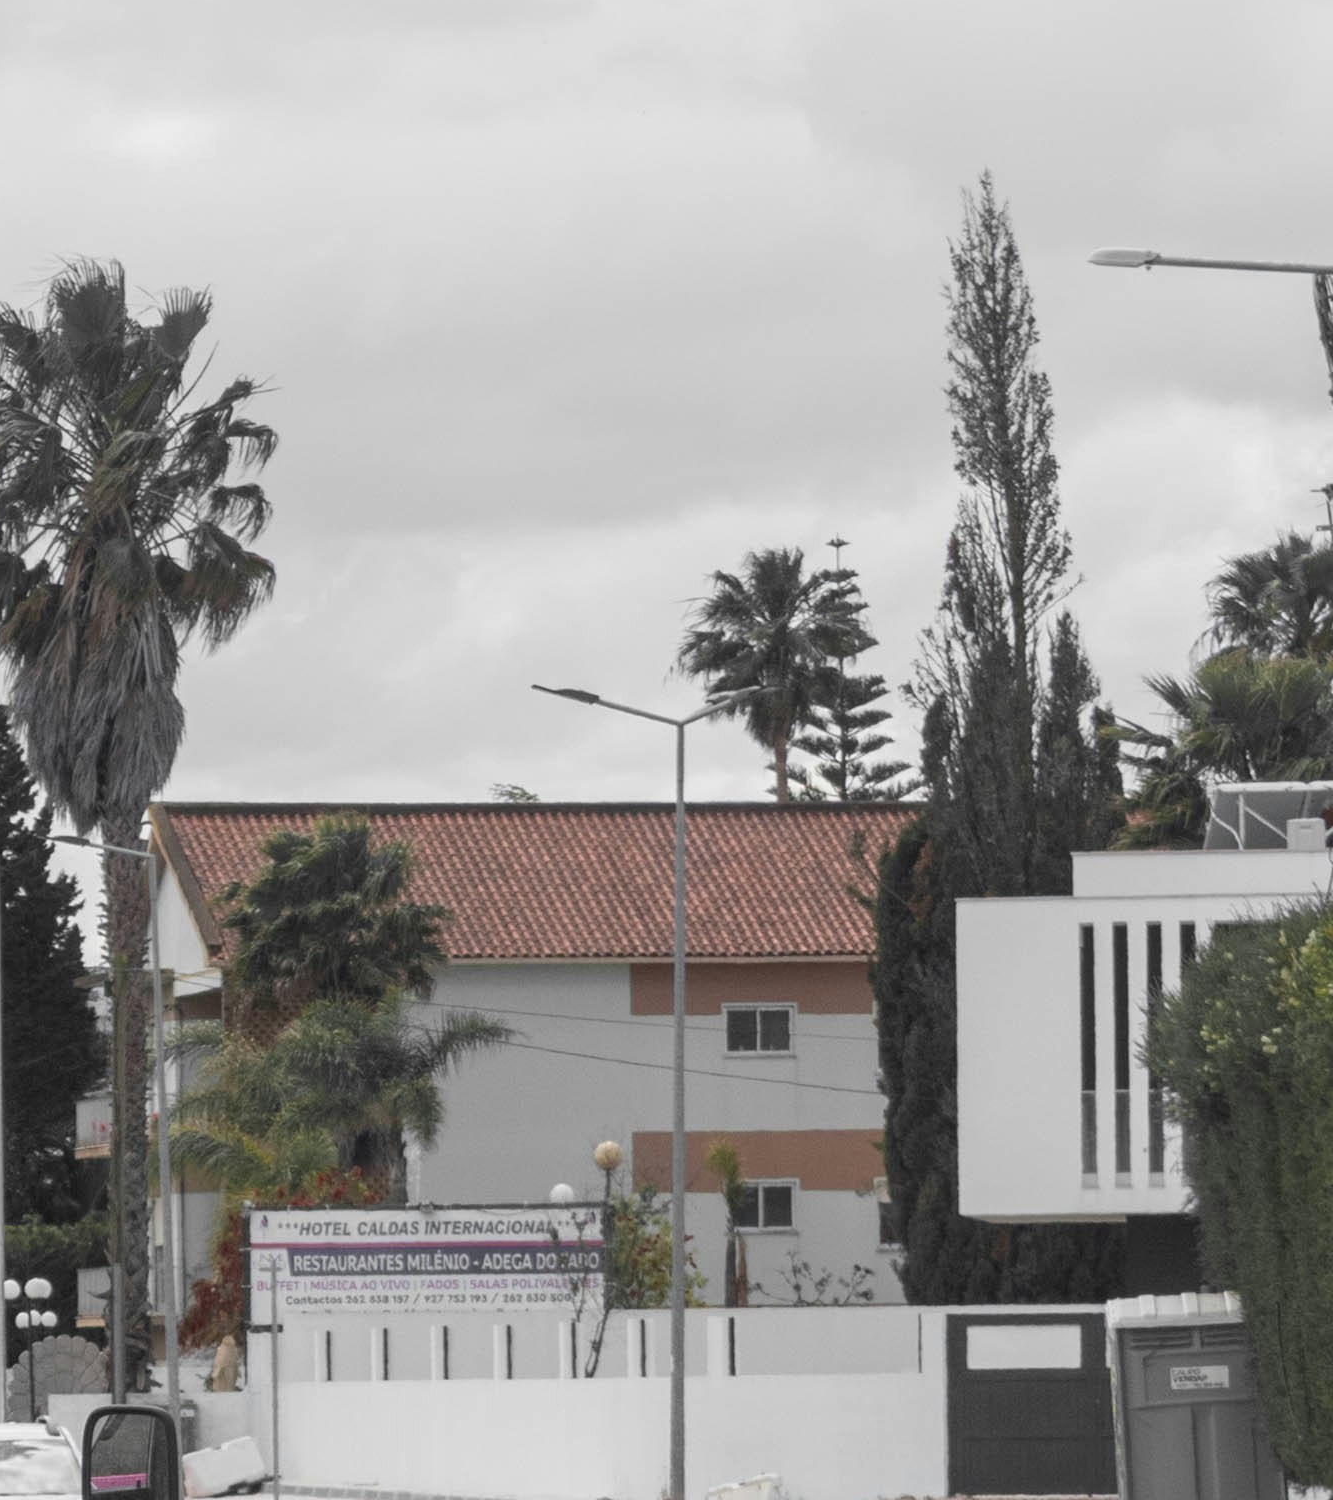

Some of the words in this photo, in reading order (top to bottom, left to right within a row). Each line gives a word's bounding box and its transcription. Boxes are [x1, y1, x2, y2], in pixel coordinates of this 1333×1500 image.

[358, 1221, 419, 1236] CALDAS
[293, 1254, 404, 1271] RESTAURANTES
[407, 1250, 469, 1271] MILÉNIO
[482, 1252, 532, 1270] ADEGA
[536, 1252, 557, 1269] DO
[257, 1280, 300, 1291] BUFET
[310, 1278, 357, 1291] MÚSICA
[360, 1280, 376, 1290] AO
[380, 1280, 410, 1290] VIVO
[420, 1279, 459, 1290] FADOS
[469, 1278, 508, 1289] SALAS
[512, 1278, 599, 1290] POLIVALEES
[286, 1295, 342, 1305] Contactos
[345, 1294, 365, 1304] 262
[503, 1293, 522, 1303] 262
